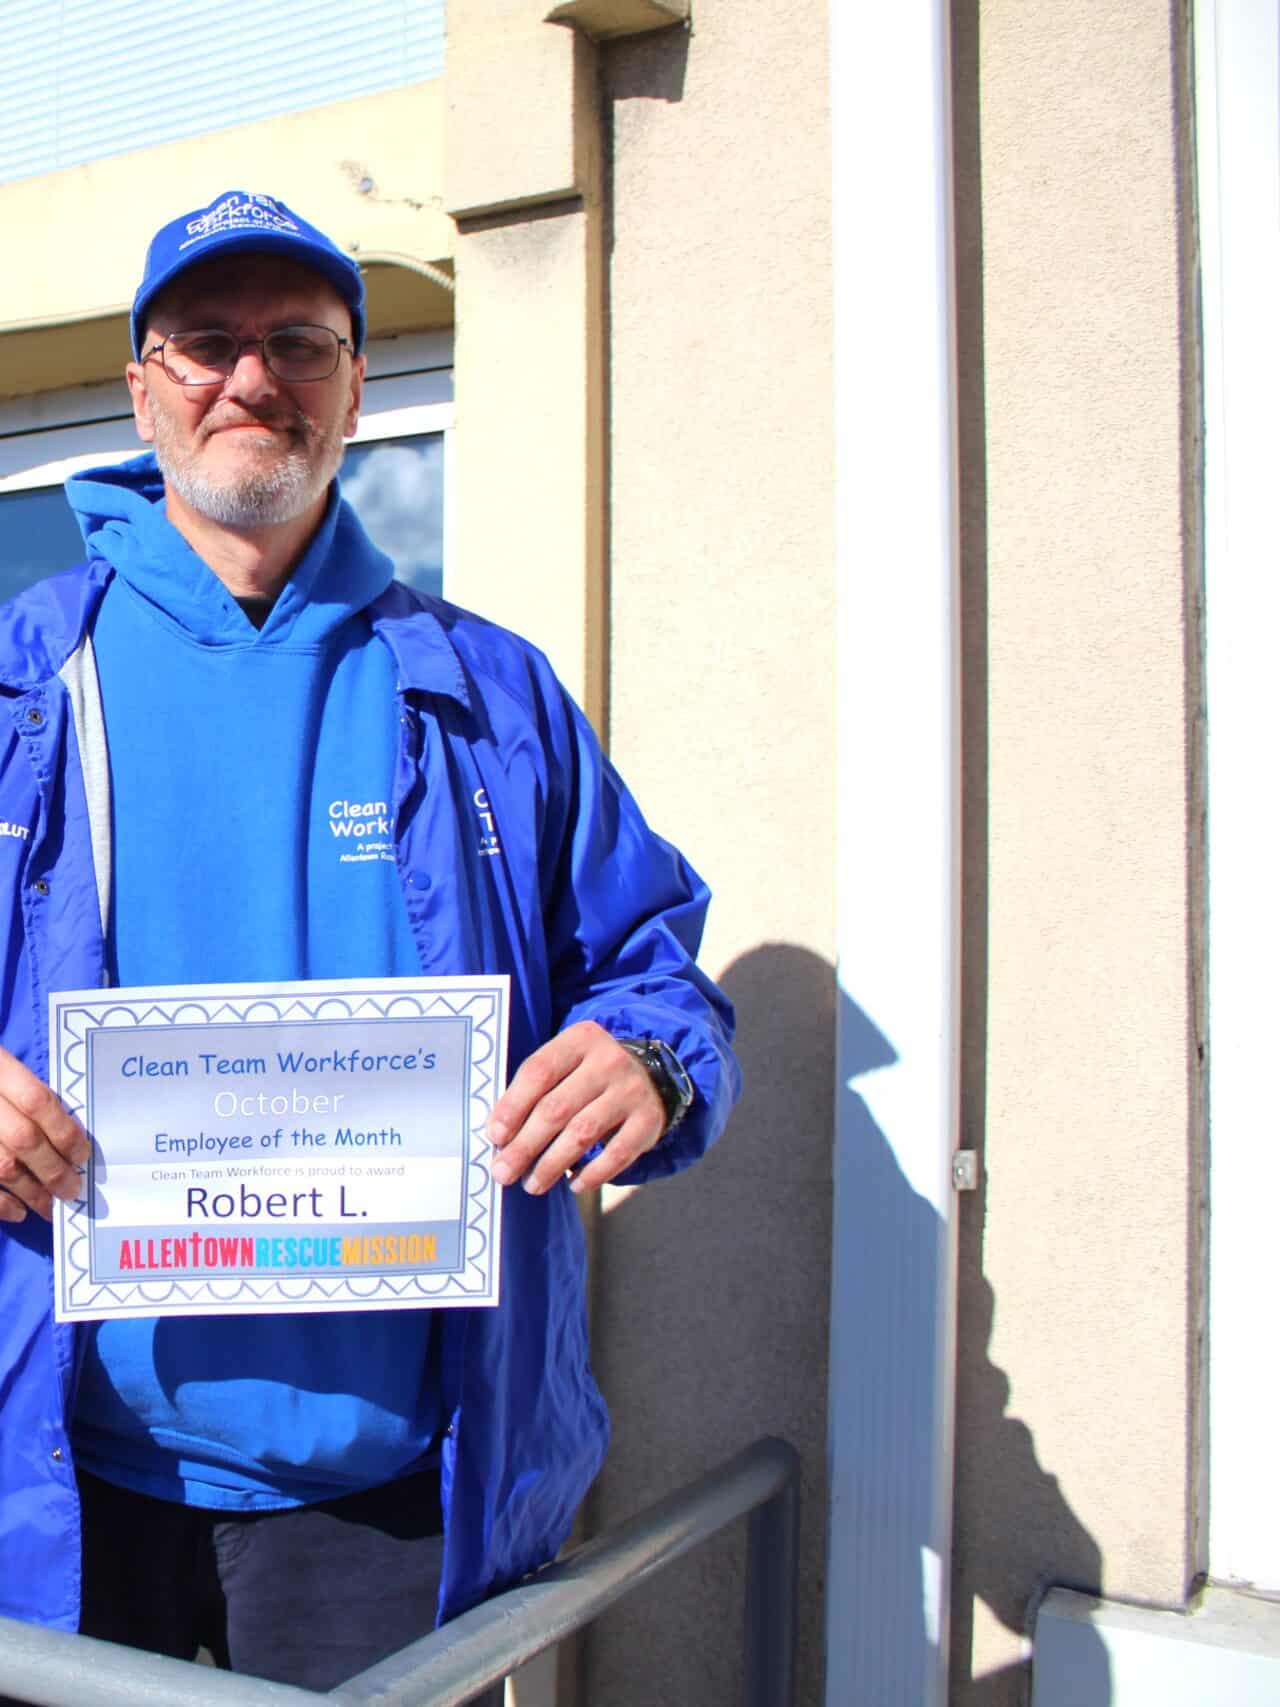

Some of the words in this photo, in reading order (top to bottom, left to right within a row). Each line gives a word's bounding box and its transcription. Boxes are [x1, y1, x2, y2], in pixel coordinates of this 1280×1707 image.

[329, 800, 387, 818] Clean
[121, 1055, 189, 1078] Clean
[199, 1053, 266, 1075] Team
[277, 1048, 437, 1073] Workforce's
[214, 1088, 344, 1118] October
[154, 1131, 253, 1156] Employee
[260, 1128, 285, 1148] of
[291, 1128, 326, 1147] the
[335, 1127, 402, 1146] Month
[151, 1169, 186, 1182] Clean
[190, 1168, 224, 1180] Team
[226, 1166, 291, 1178] Workforce
[295, 1166, 305, 1177] is
[308, 1165, 347, 1180] proud
[350, 1165, 363, 1177] to
[366, 1165, 406, 1177] award
[186, 1183, 324, 1219] Robert
[339, 1185, 369, 1218] L.
